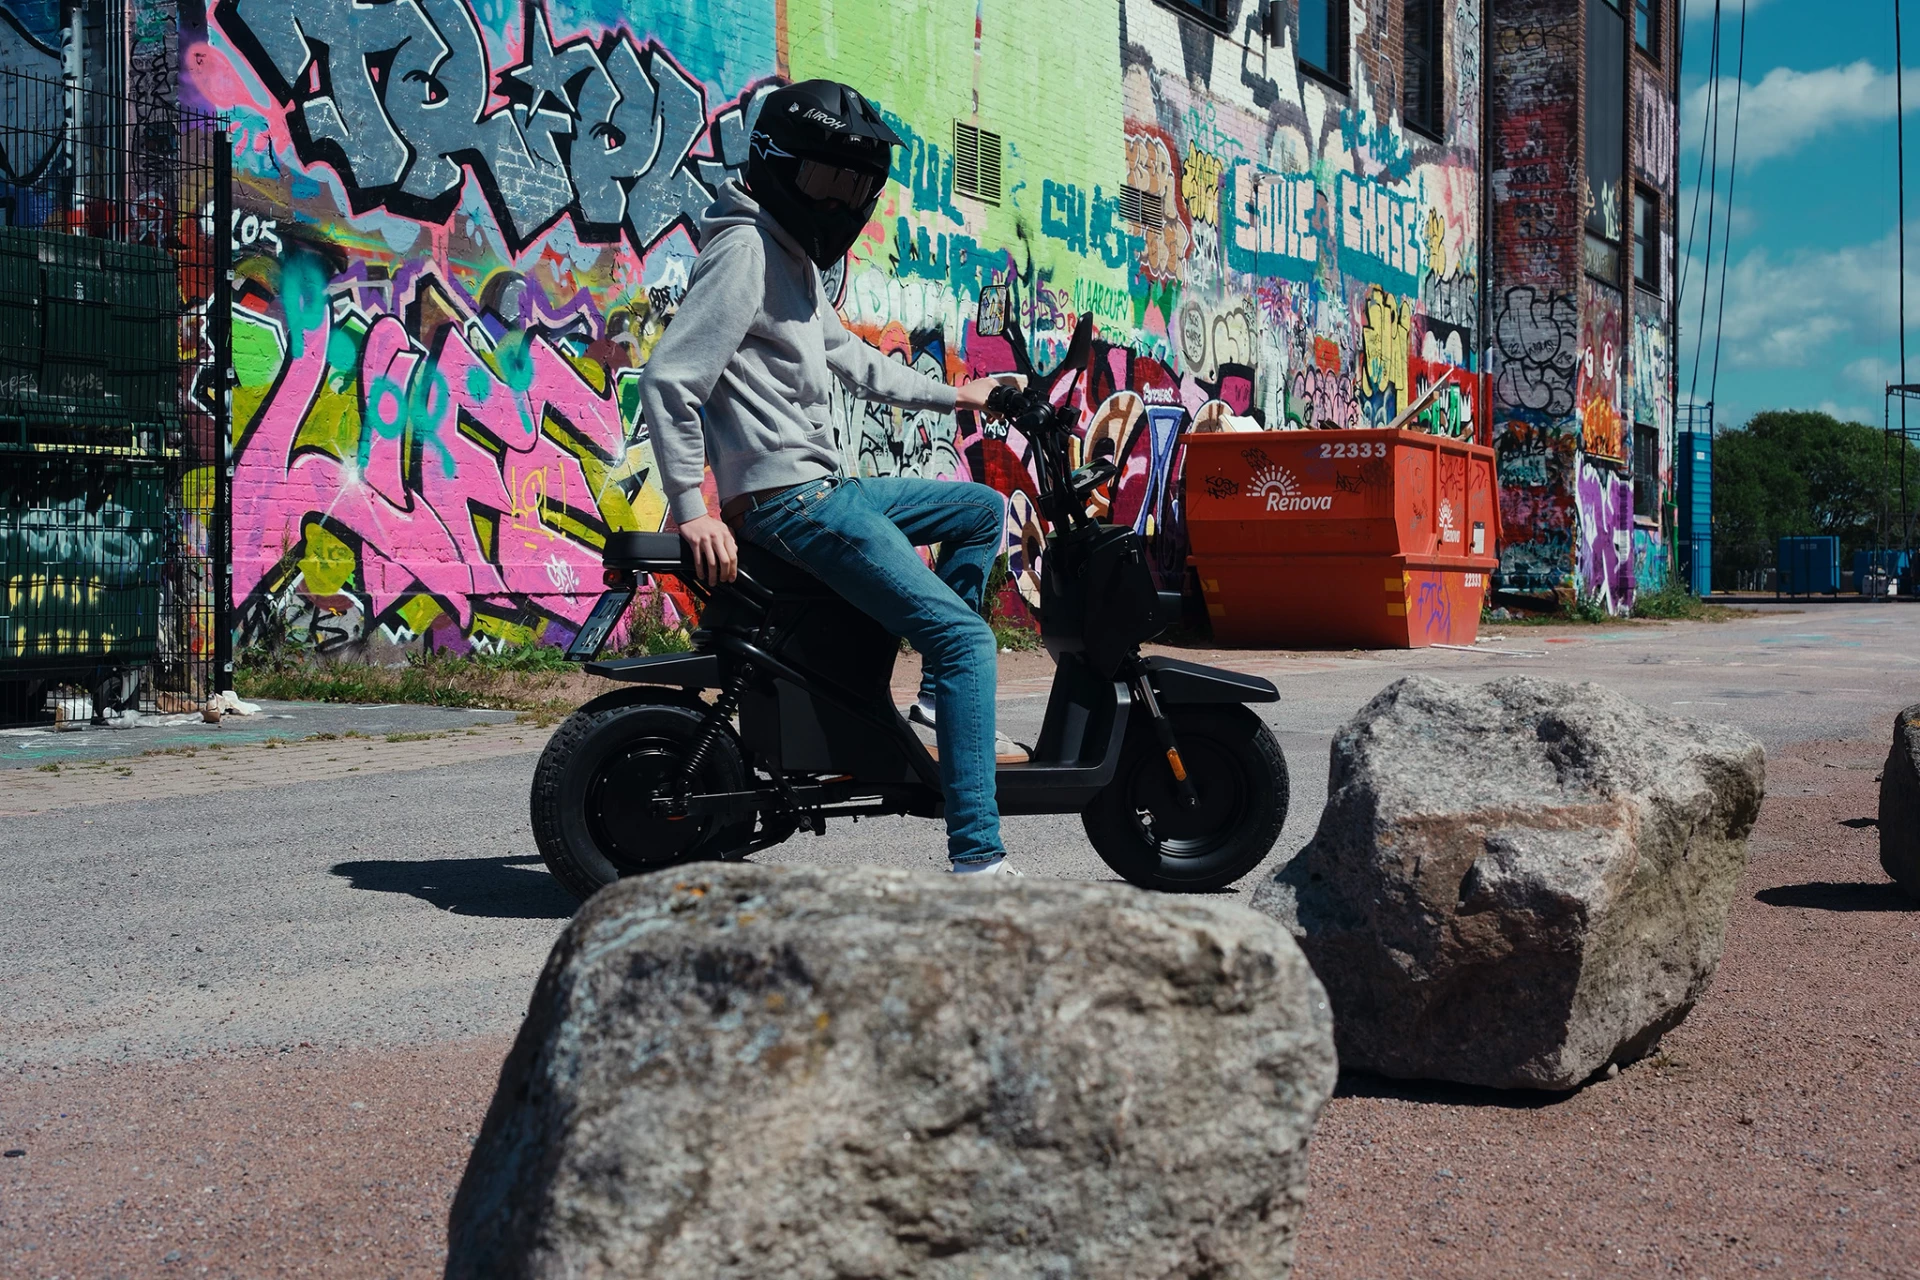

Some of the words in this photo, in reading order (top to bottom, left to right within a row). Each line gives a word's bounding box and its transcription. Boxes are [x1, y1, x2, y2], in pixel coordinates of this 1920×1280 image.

[803, 108, 846, 130] AIROH
[1342, 173, 1418, 276] CHASE
[1320, 443, 1386, 458] 22333
[1266, 492, 1332, 511] Renova
[1443, 524, 1461, 543] Renova
[1464, 573, 1481, 588] 22333
